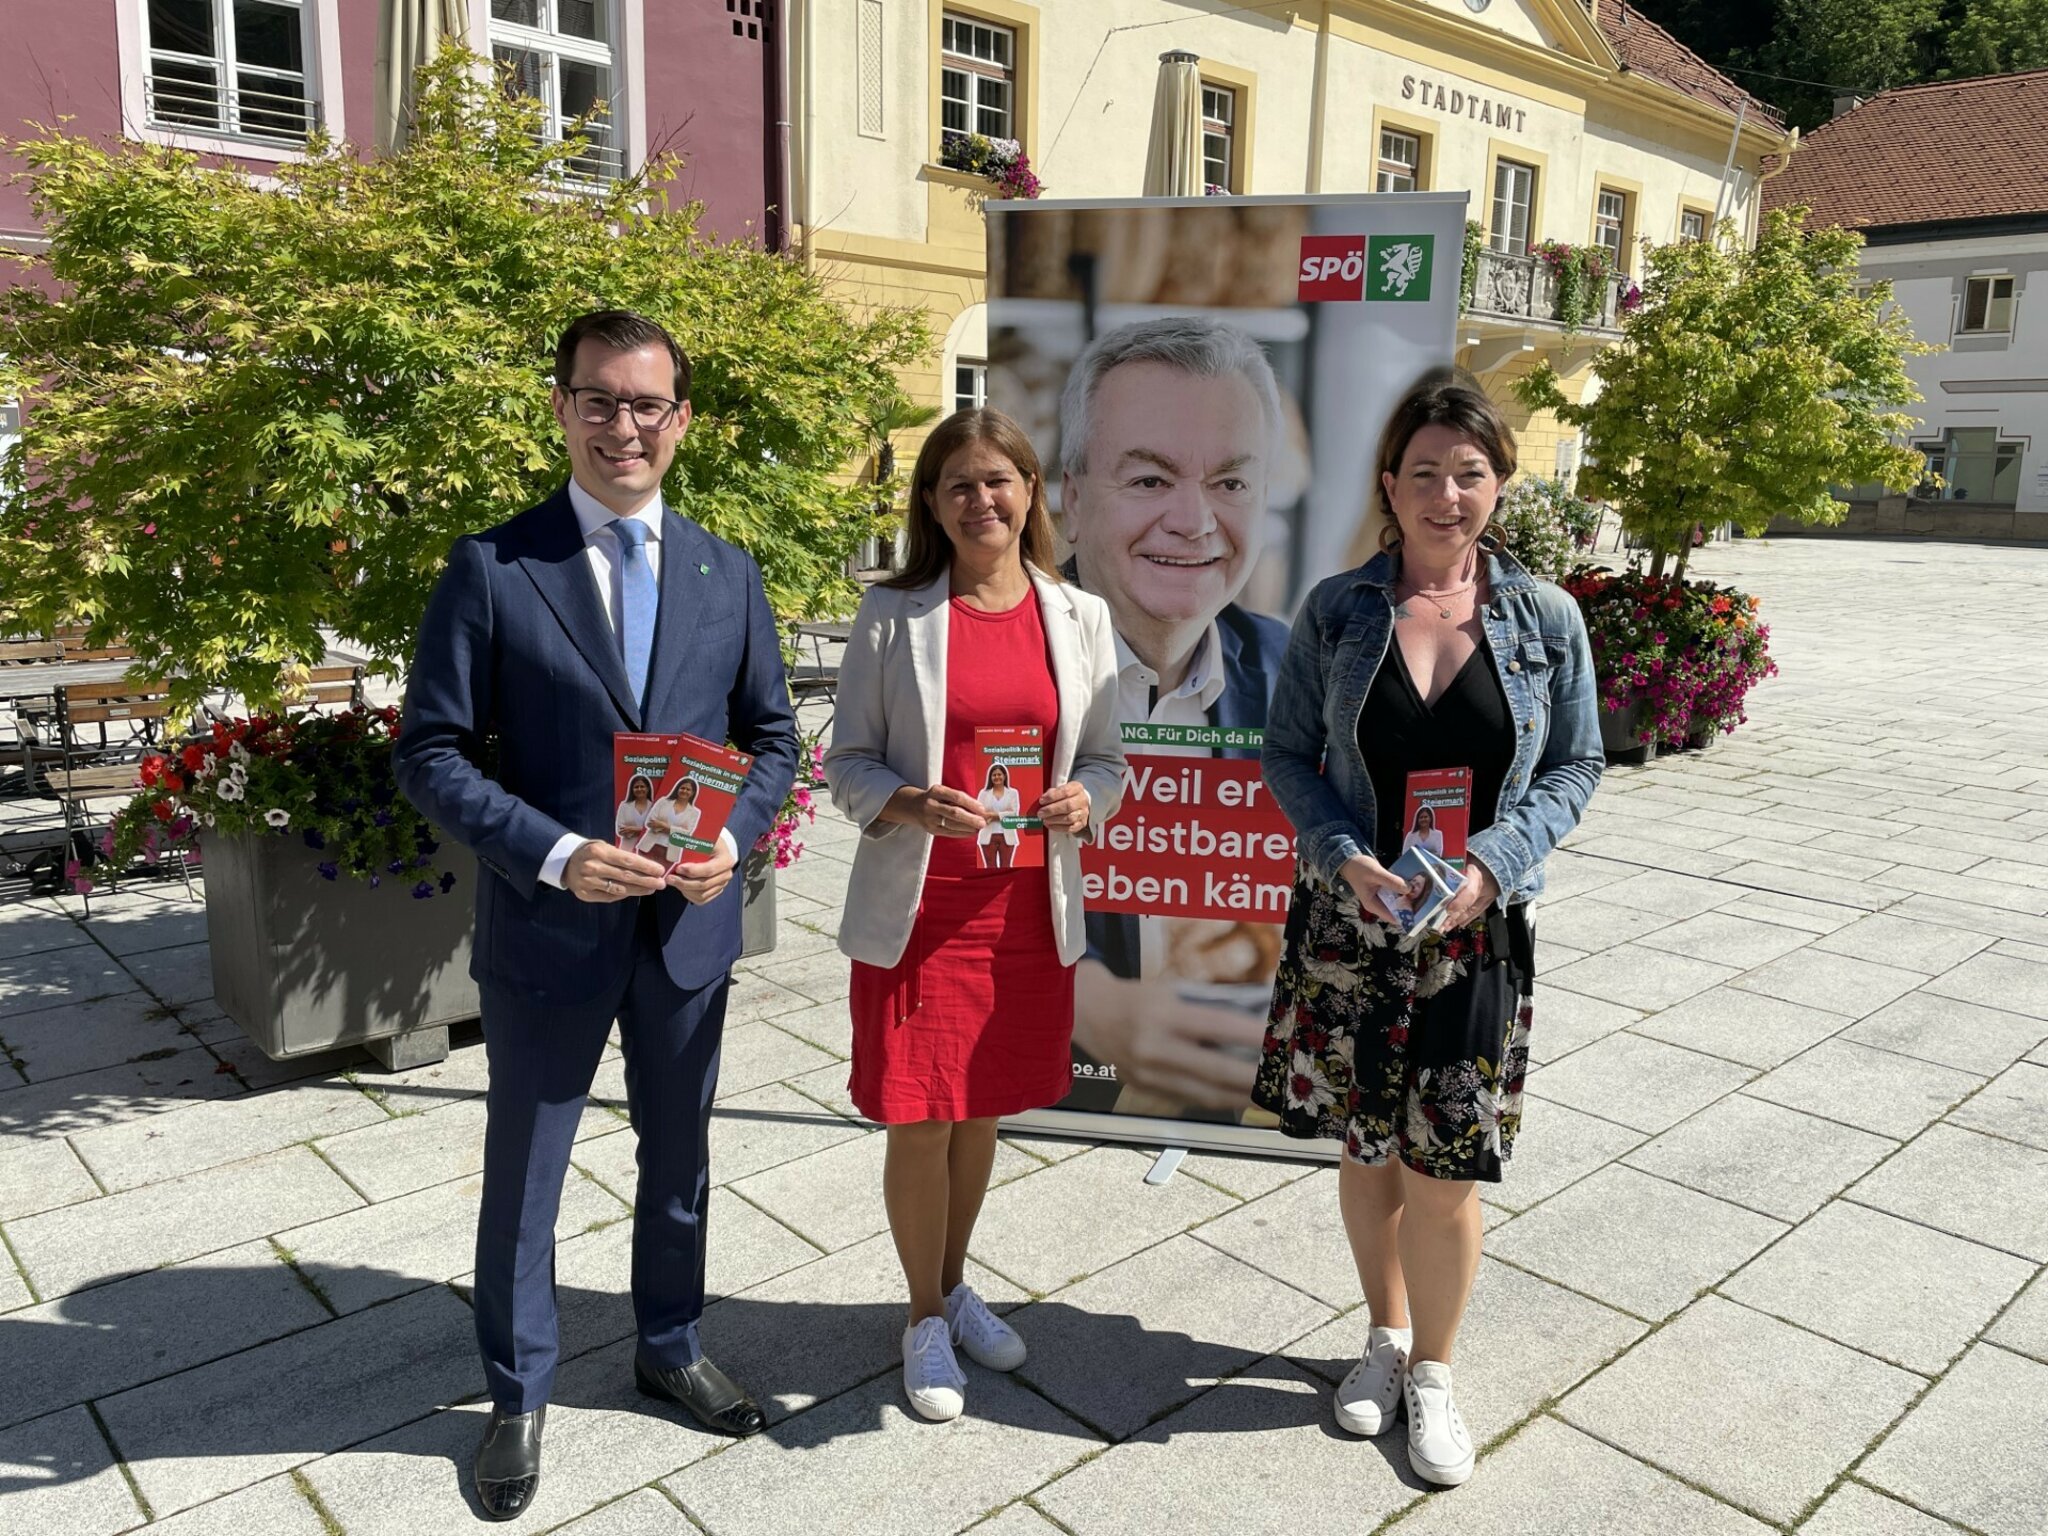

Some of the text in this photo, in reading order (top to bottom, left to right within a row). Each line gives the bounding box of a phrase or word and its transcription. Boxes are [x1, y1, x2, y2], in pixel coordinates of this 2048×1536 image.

[1401, 75, 1526, 133] STADTAMT
[1299, 250, 1363, 282] SPÖ
[1157, 728, 1182, 742] Für
[1186, 730, 1221, 744] Dich
[1225, 732, 1244, 745] da
[1249, 732, 1264, 745] in
[624, 755, 668, 764] Sozialpolitik
[983, 746, 1021, 754] Sozialpolitik
[993, 755, 1041, 765] Steiermark
[636, 766, 666, 777] Steier
[681, 756, 723, 776] Sozialpolitik
[722, 770, 731, 778] in
[731, 773, 743, 782] der
[689, 770, 739, 793] Steiermark
[1121, 765, 1263, 808] Weil er
[1422, 797, 1465, 808] Steiermark
[1097, 815, 1298, 860] leistbare
[1082, 865, 1292, 912] eben käm
[1072, 1062, 1117, 1080] oe.at
